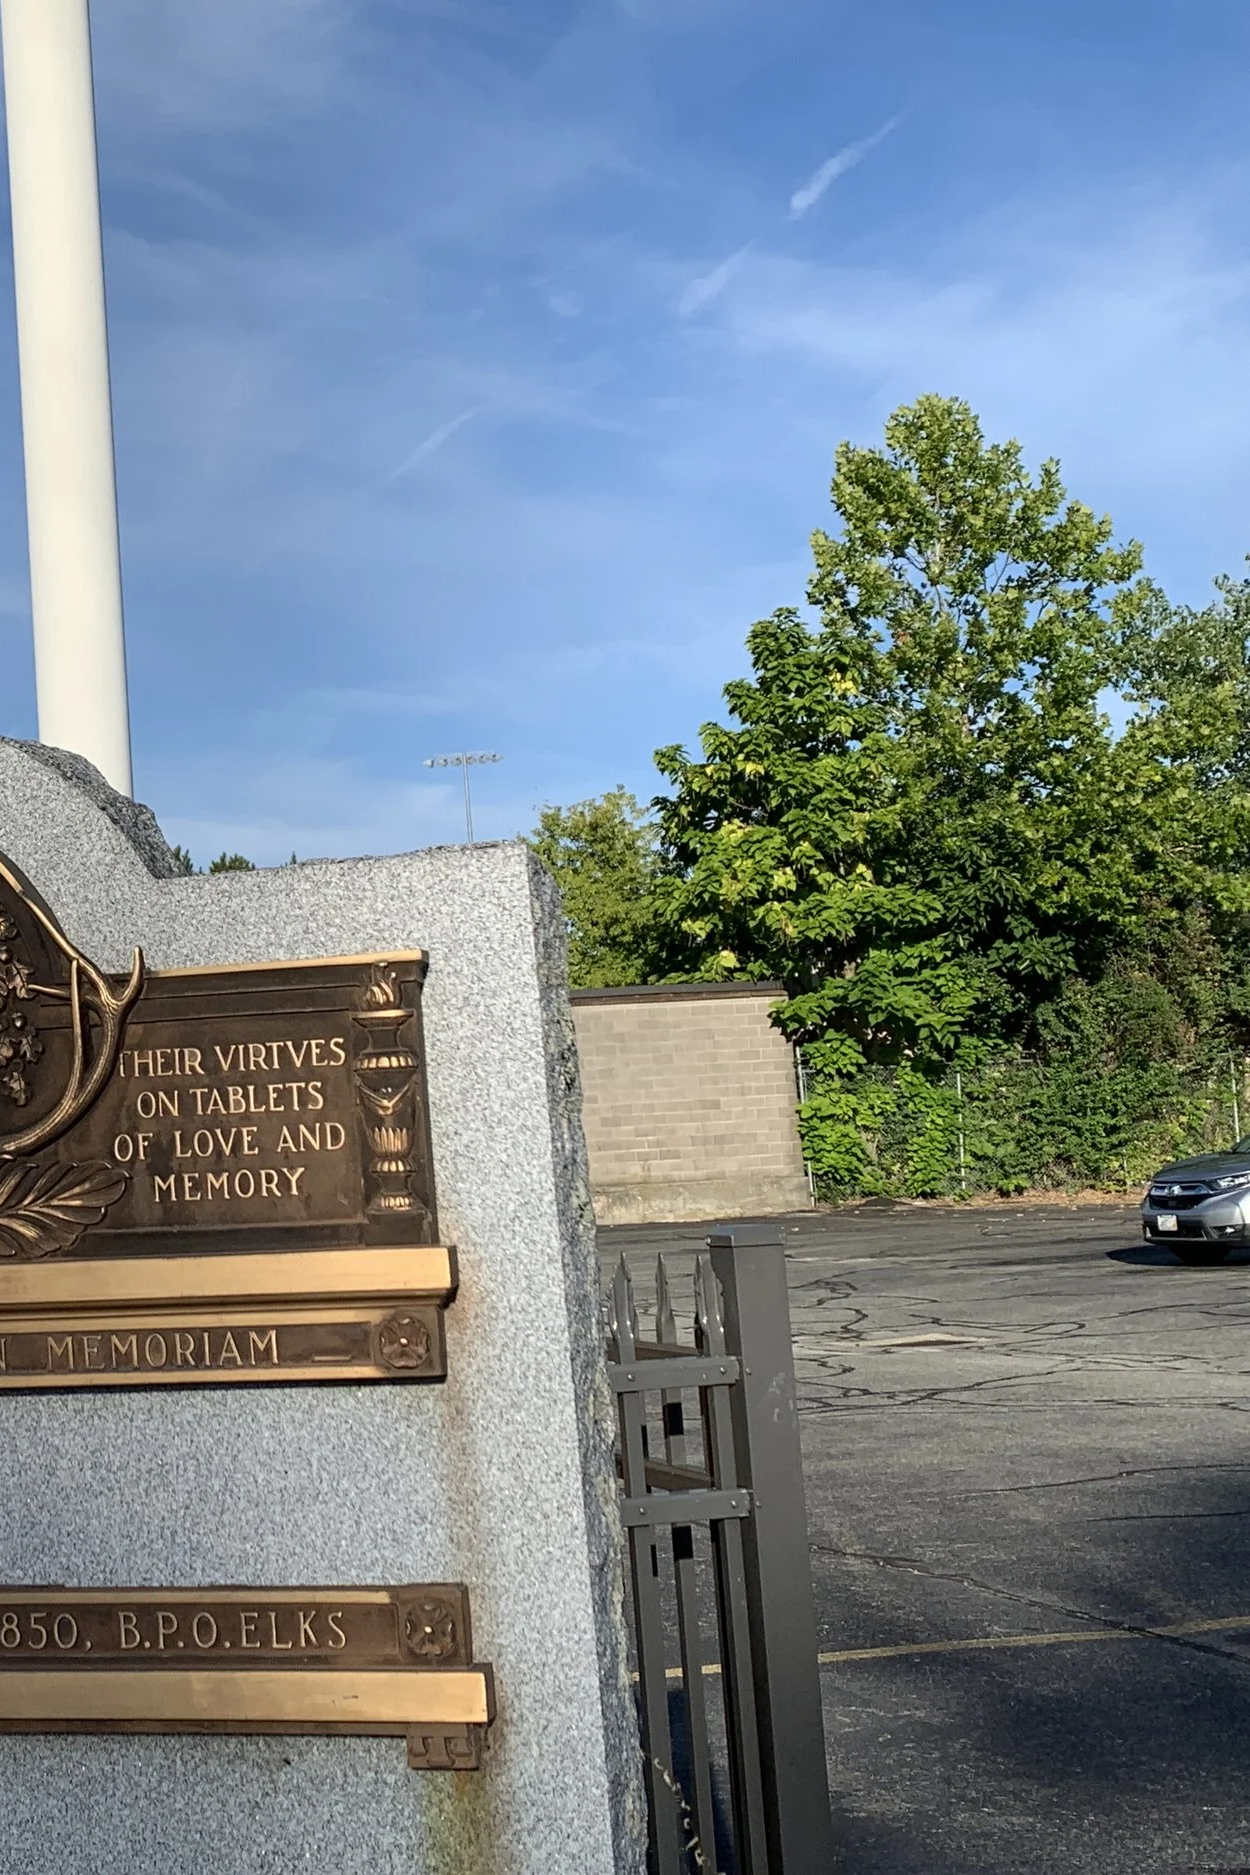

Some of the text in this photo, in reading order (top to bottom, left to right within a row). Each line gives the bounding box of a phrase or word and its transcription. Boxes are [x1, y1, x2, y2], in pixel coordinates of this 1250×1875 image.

[214, 1037, 346, 1073] VIRTVES
[137, 1081, 324, 1119] ON TABLETS
[114, 1122, 346, 1162] OF LOVE AND
[154, 1167, 305, 1202] MEMORY
[48, 1329, 280, 1371] MEMORIAM
